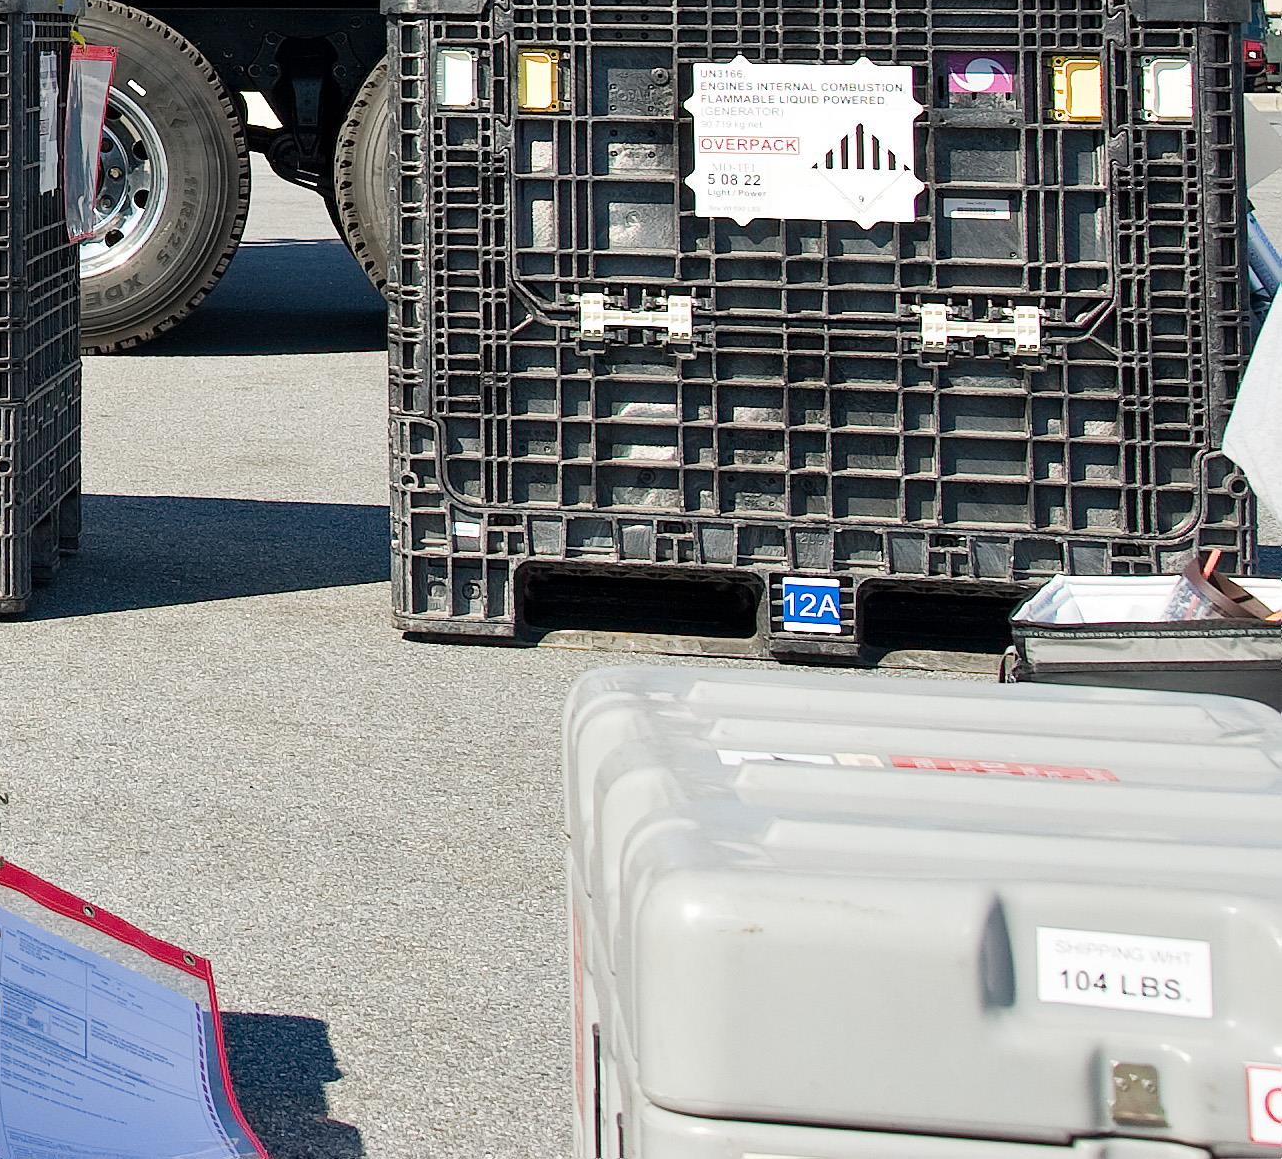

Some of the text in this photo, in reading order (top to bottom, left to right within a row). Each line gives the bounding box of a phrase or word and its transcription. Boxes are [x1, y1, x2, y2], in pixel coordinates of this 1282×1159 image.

[699, 82, 753, 91] ENGINES
[756, 82, 817, 91] INTERNAL
[699, 95, 775, 104] FLAMMABLE
[778, 95, 820, 105] LIQUID
[699, 107, 785, 118] (GENERATOR)
[700, 138, 797, 152] OVERPACK
[707, 174, 761, 186] 5 08 22
[706, 189, 731, 198] Light
[783, 591, 841, 619] 12A
[1054, 940, 1145, 960] SHIPPING
[1061, 969, 1192, 1002] 104 LBS.
